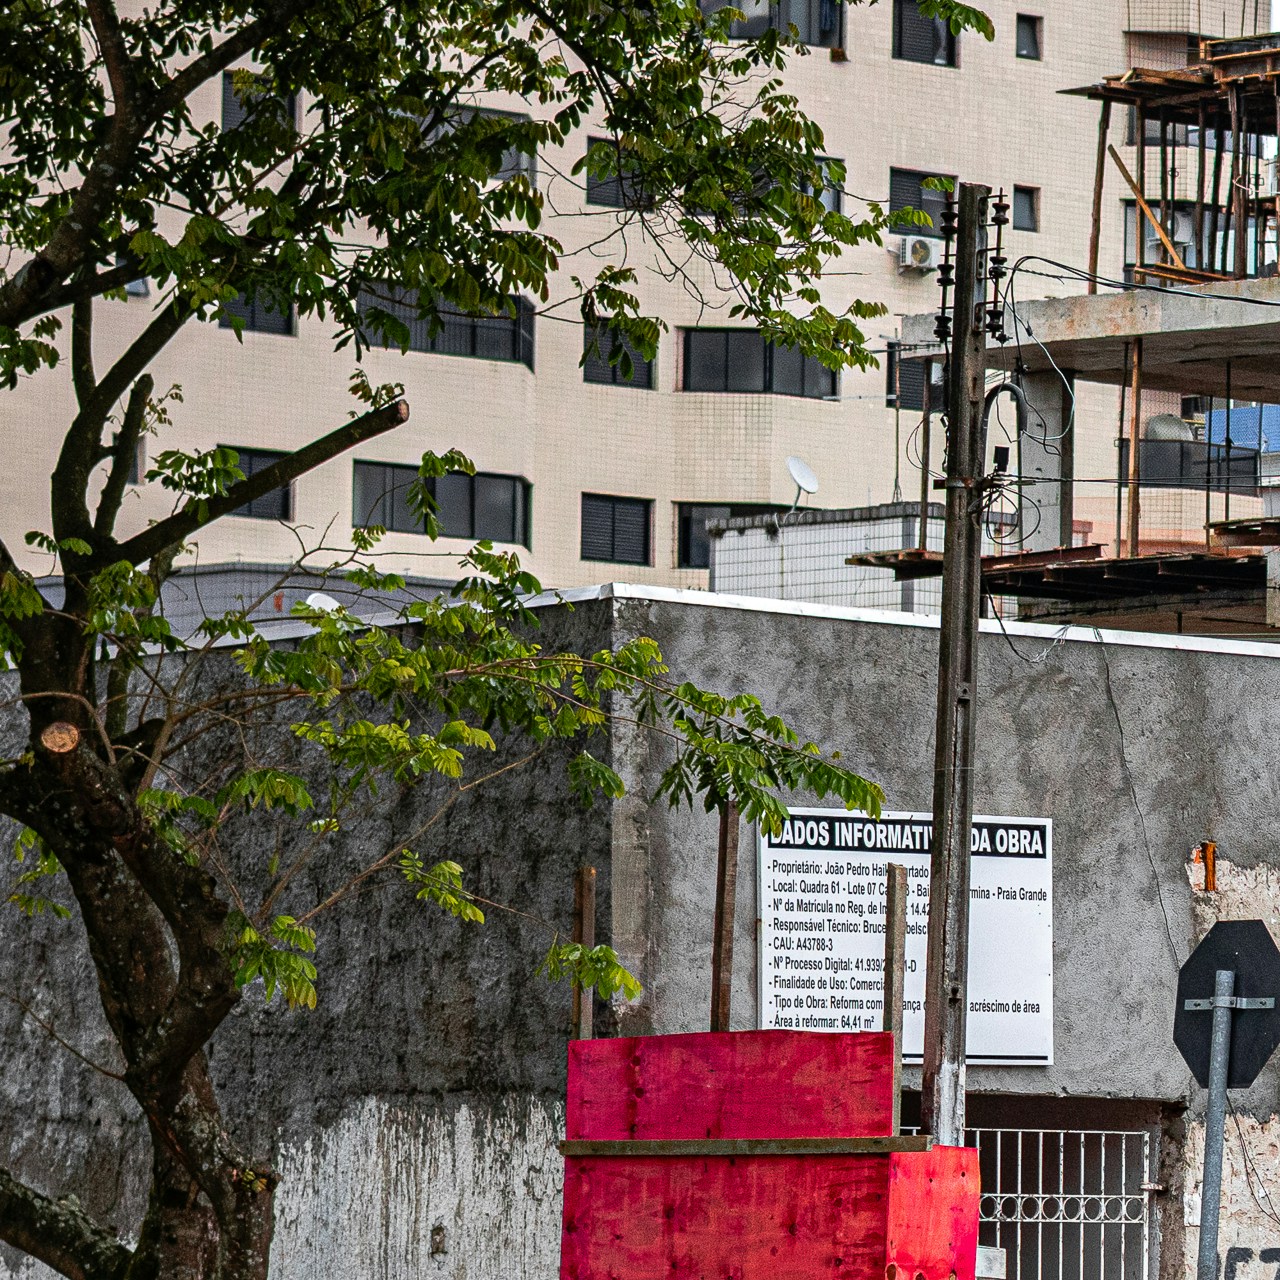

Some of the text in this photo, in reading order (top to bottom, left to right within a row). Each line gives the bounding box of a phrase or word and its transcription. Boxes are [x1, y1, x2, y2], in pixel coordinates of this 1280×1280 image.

[995, 828, 1043, 854] OBRA
[773, 860, 823, 876] Proprietário:
[824, 862, 844, 875] João
[846, 863, 870, 876] Pedro
[773, 879, 797, 892] Local:
[800, 880, 829, 894] Quadra
[831, 881, 840, 894] 61
[847, 882, 865, 895] Lote
[867, 882, 876, 895] 07
[997, 887, 1017, 900] Praia
[1019, 887, 1047, 901] Grande
[785, 898, 794, 912] da
[796, 899, 833, 913] Matrícula
[835, 904, 845, 914] no
[847, 900, 866, 917] Reg.
[867, 901, 877, 914] de
[773, 918, 825, 934] Responsável
[827, 919, 861, 933] Técnico:
[773, 937, 833, 951] CAU: A43788-3
[785, 956, 823, 970] Processo
[824, 957, 853, 974] Digital:
[774, 975, 815, 989] Finalidade
[817, 976, 827, 989] de
[829, 976, 848, 990] Uso:
[774, 994, 792, 1011] Tipo
[794, 995, 804, 1008] de
[806, 995, 828, 1009] Obra:
[830, 996, 864, 1010] Reforma
[866, 1000, 883, 1010] com
[969, 999, 1010, 1013] acréscimo
[1011, 1000, 1021, 1013] de
[1023, 1000, 1041, 1013] área
[774, 1011, 793, 1028] Área
[801, 1014, 839, 1028] reformar:
[841, 1015, 861, 1030] 64,41
